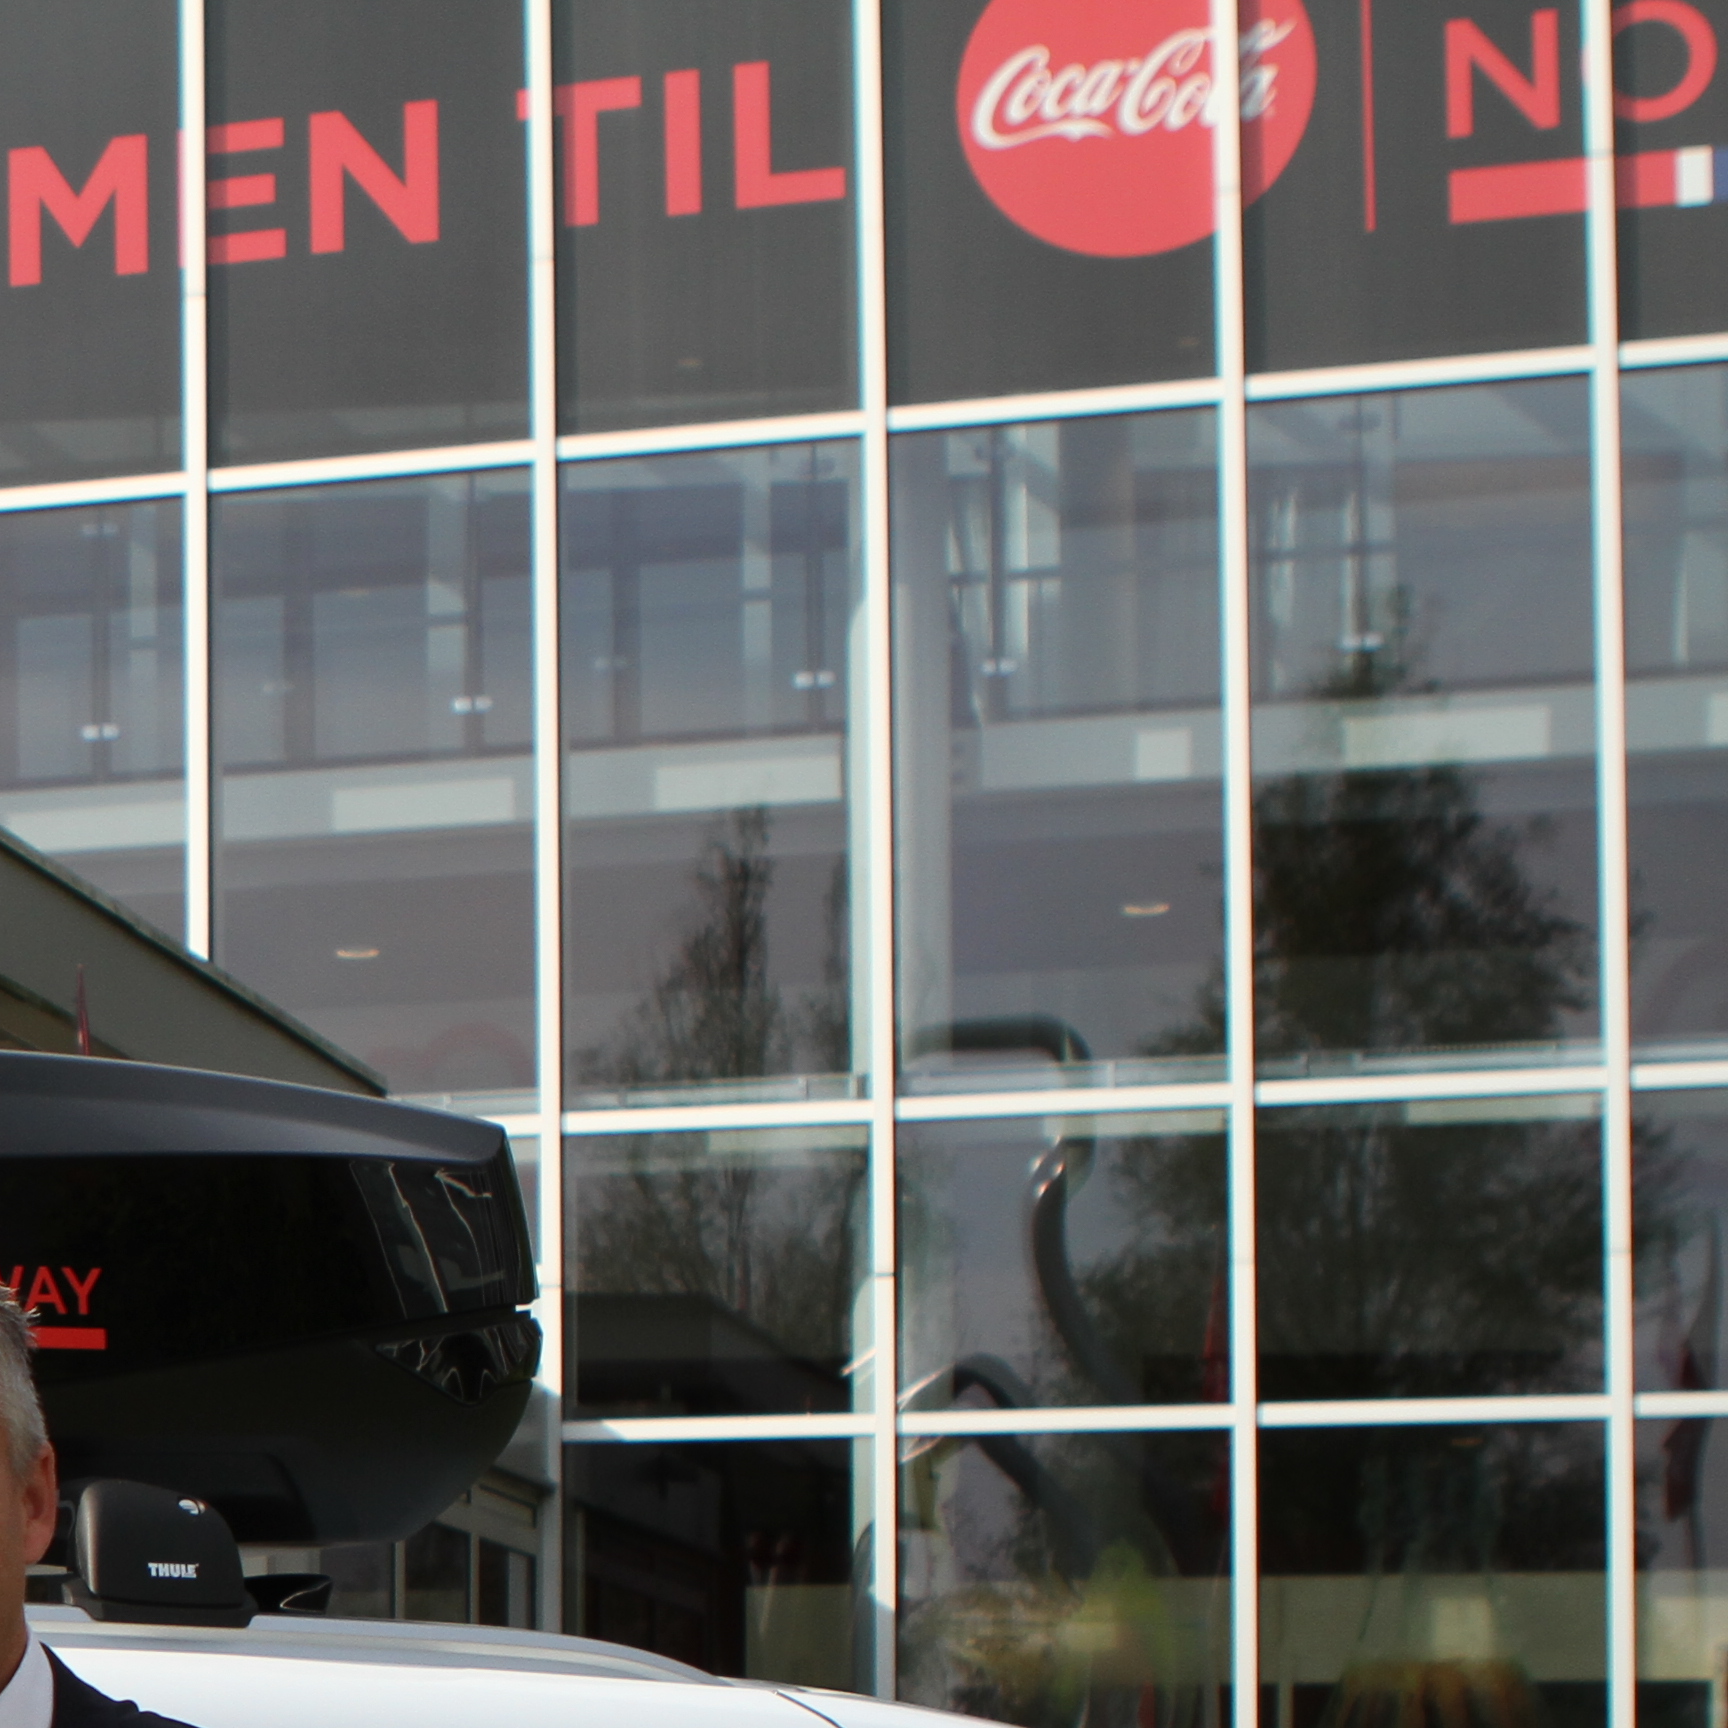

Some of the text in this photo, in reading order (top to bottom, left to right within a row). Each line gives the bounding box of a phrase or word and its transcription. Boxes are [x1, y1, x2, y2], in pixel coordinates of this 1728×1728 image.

[517, 60, 846, 227] TIL
[971, 17, 1297, 150] Coca-Coa
[147, 1562, 197, 1579] THULE
